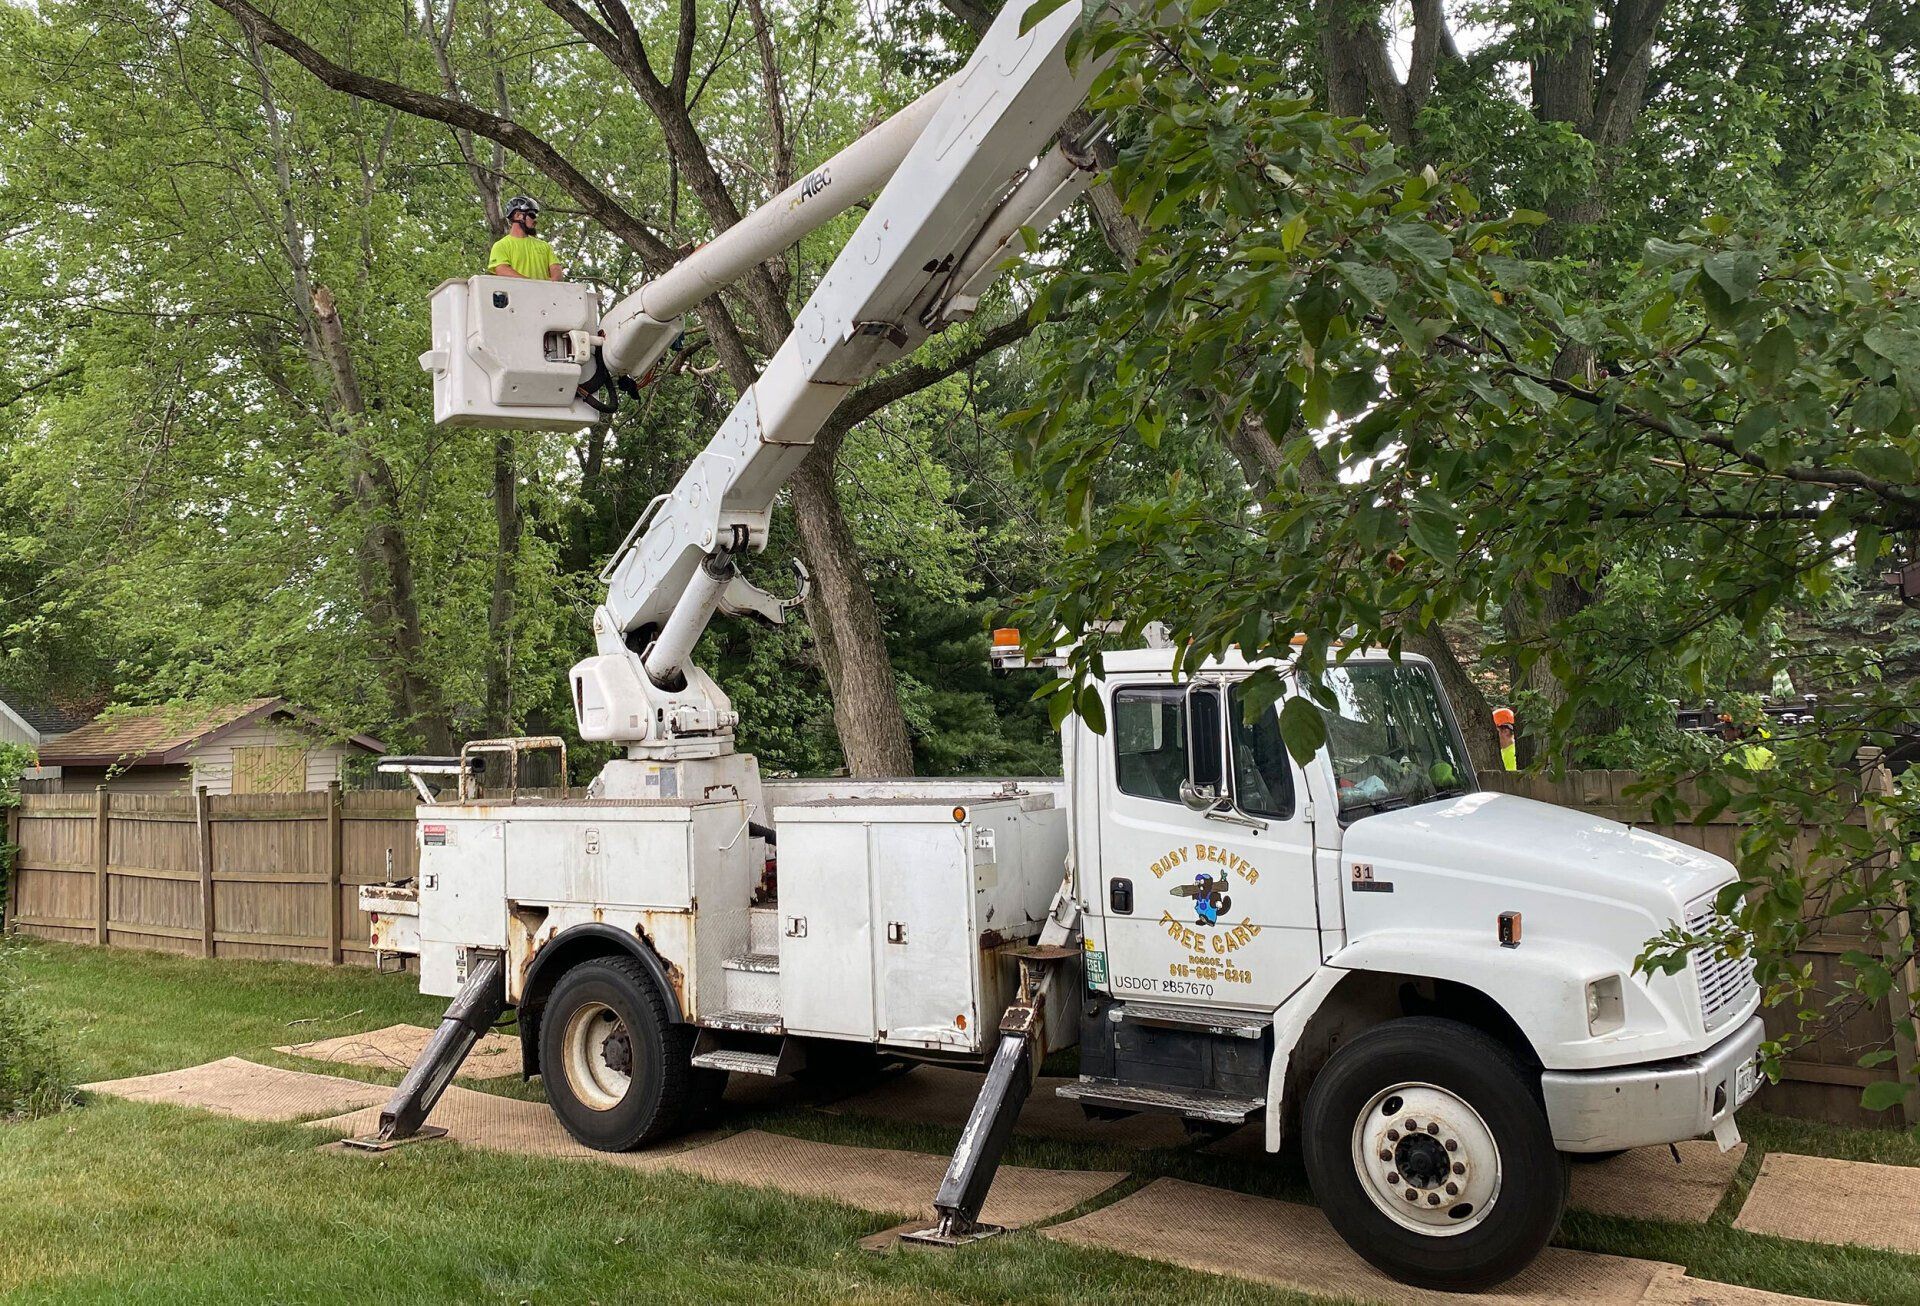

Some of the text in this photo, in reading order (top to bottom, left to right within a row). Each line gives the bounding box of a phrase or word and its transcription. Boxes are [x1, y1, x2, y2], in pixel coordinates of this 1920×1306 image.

[801, 167, 832, 202] Altec
[1150, 844, 1260, 885] BUSY BEAVER
[1354, 865, 1373, 879] 31
[1158, 910, 1262, 954] TREE CARE
[1114, 975, 1158, 991] USDOT
